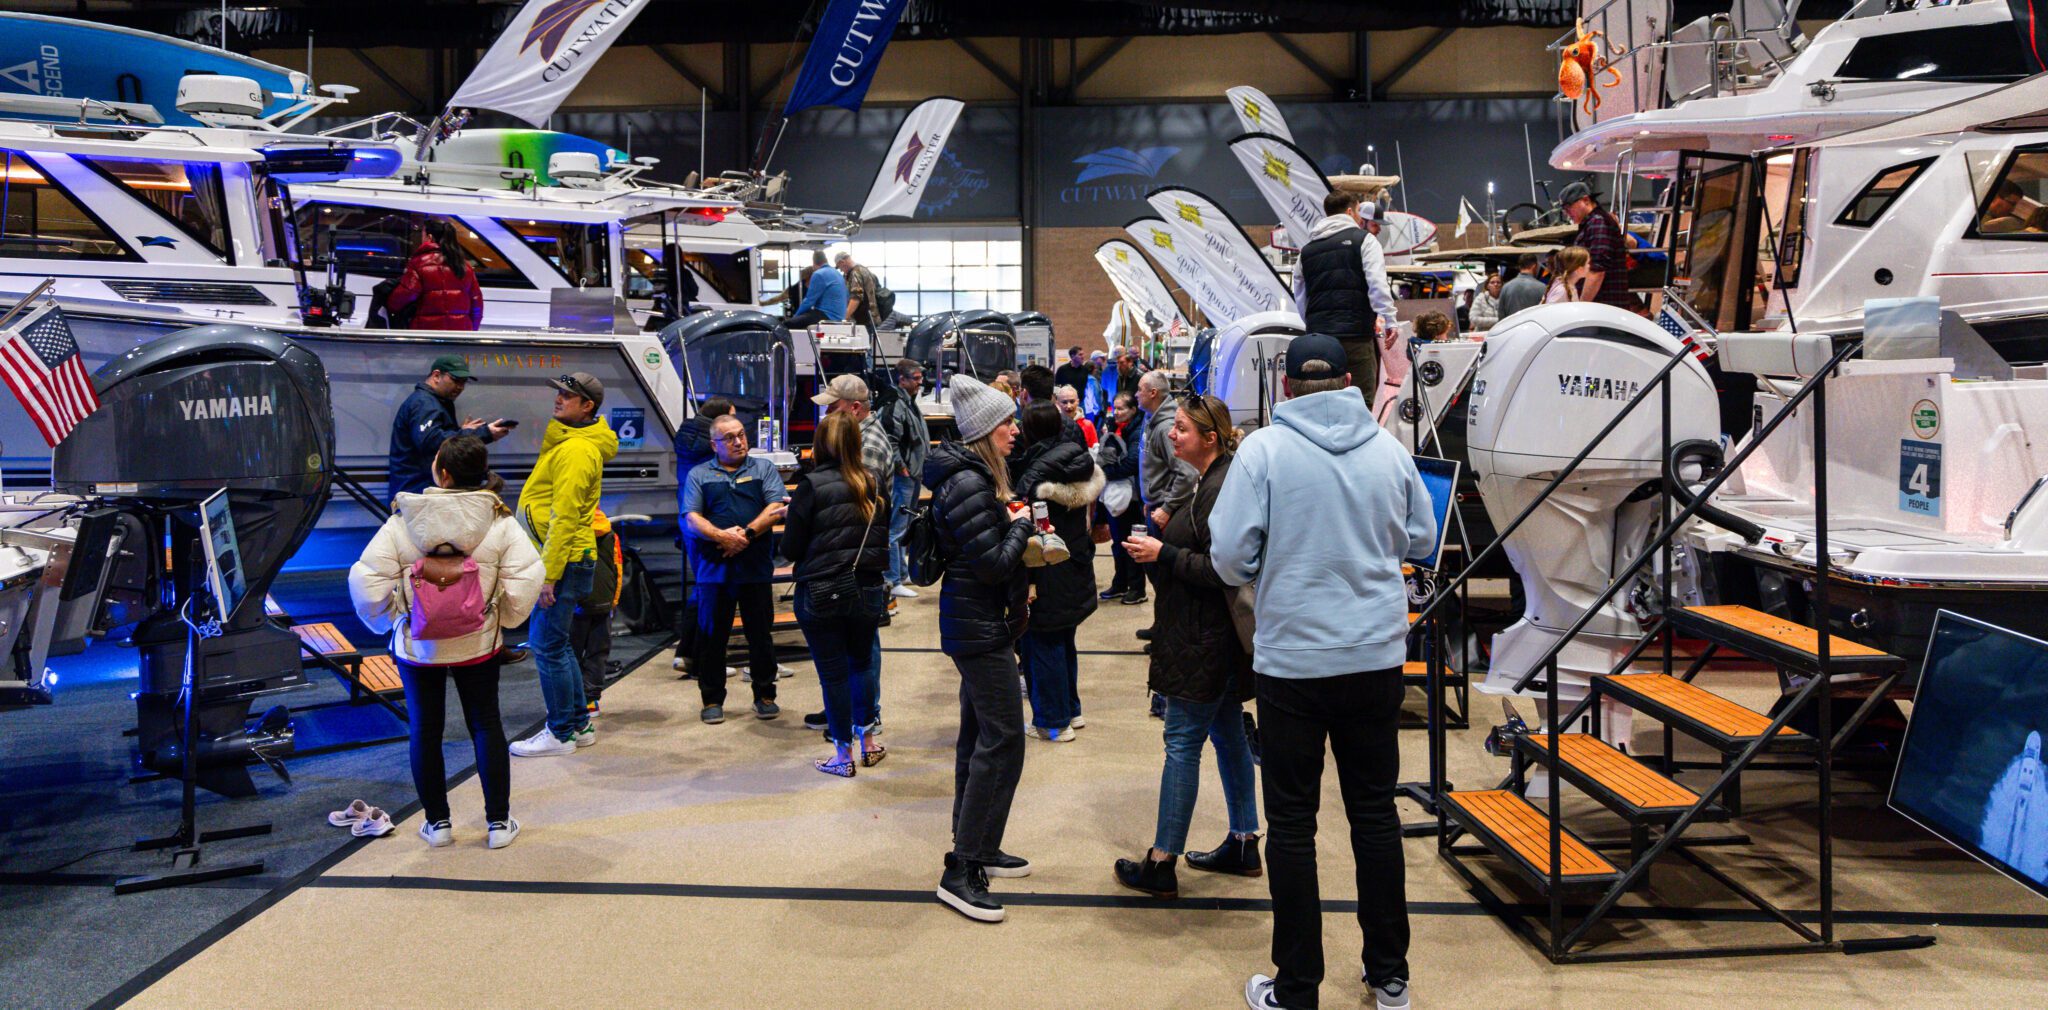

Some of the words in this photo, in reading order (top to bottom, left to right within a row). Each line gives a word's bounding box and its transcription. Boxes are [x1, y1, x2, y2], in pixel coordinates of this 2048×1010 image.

[542, 0, 633, 83] CUTWATE
[829, 0, 889, 87] CUTW
[906, 133, 941, 196] CUTWATER
[1059, 182, 1184, 203] CUTWAT
[464, 353, 561, 369] UTWATER
[1558, 374, 1639, 401] YAMAHA
[178, 395, 274, 421] YAMAHA
[618, 419, 637, 440] 6
[1908, 463, 1930, 497] 4
[1908, 498, 1930, 511] PEOPLE
